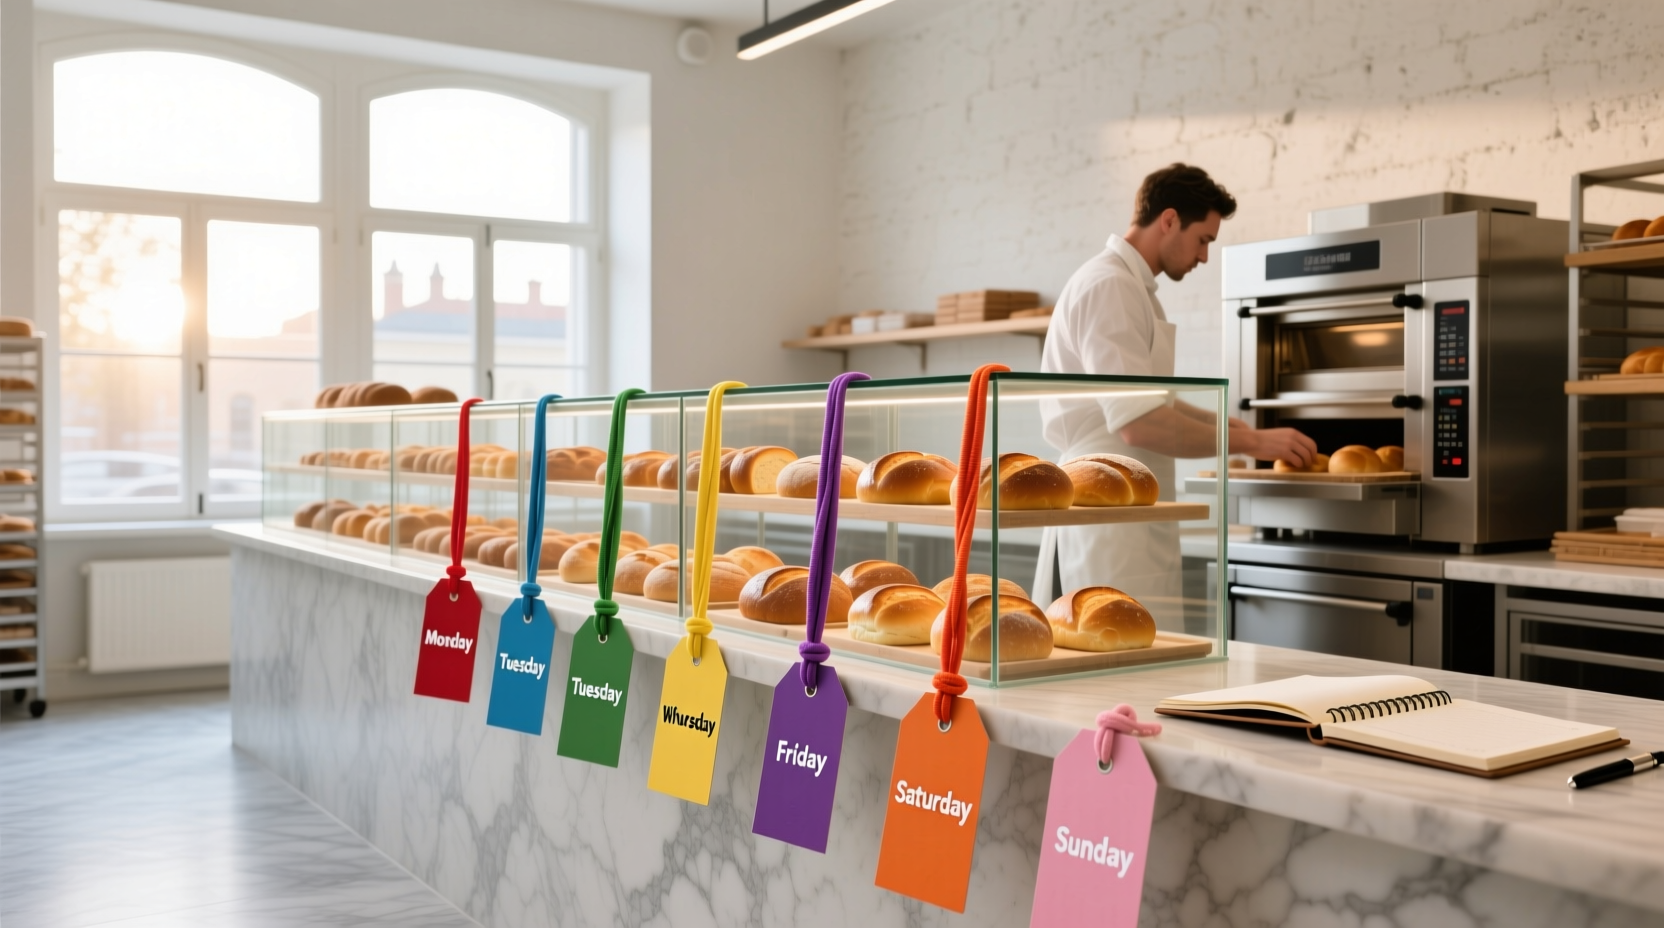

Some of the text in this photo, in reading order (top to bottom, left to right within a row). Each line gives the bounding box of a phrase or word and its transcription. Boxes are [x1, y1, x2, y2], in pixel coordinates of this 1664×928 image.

[500, 652, 546, 680] Tuesday
[572, 677, 623, 707] Tuesday
[776, 740, 828, 777] Friday
[894, 780, 973, 826] Saturday
[1054, 826, 1135, 878] Sunday
